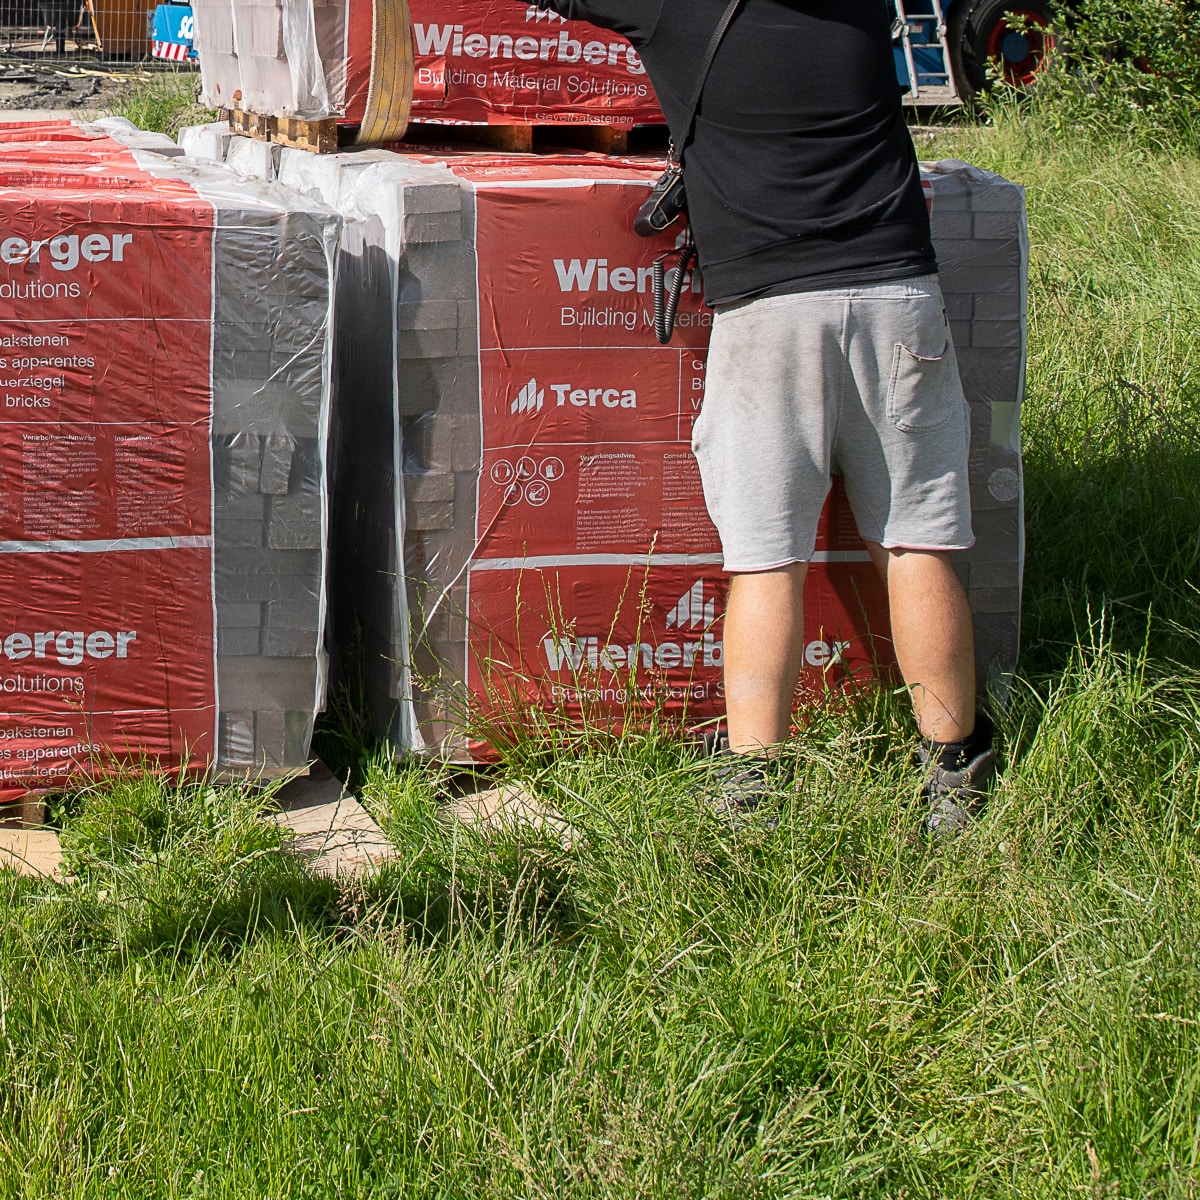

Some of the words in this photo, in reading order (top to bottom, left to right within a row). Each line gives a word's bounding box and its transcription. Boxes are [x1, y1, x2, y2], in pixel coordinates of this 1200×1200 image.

[413, 22, 646, 75] Wienerberg
[418, 66, 490, 90] Building
[493, 68, 561, 92] Material
[566, 74, 648, 98] Solutions
[535, 111, 634, 124] Gevelbakstenen
[554, 258, 704, 292] Wiener
[561, 308, 637, 330] Building
[643, 308, 712, 327] Mteria
[12, 354, 95, 372] apparentes
[5, 393, 51, 408] bricks
[550, 384, 638, 409] Terca
[544, 632, 850, 670] Wienerber
[551, 682, 628, 704] Building
[634, 681, 709, 699] Material
[16, 742, 100, 760] apparentes
